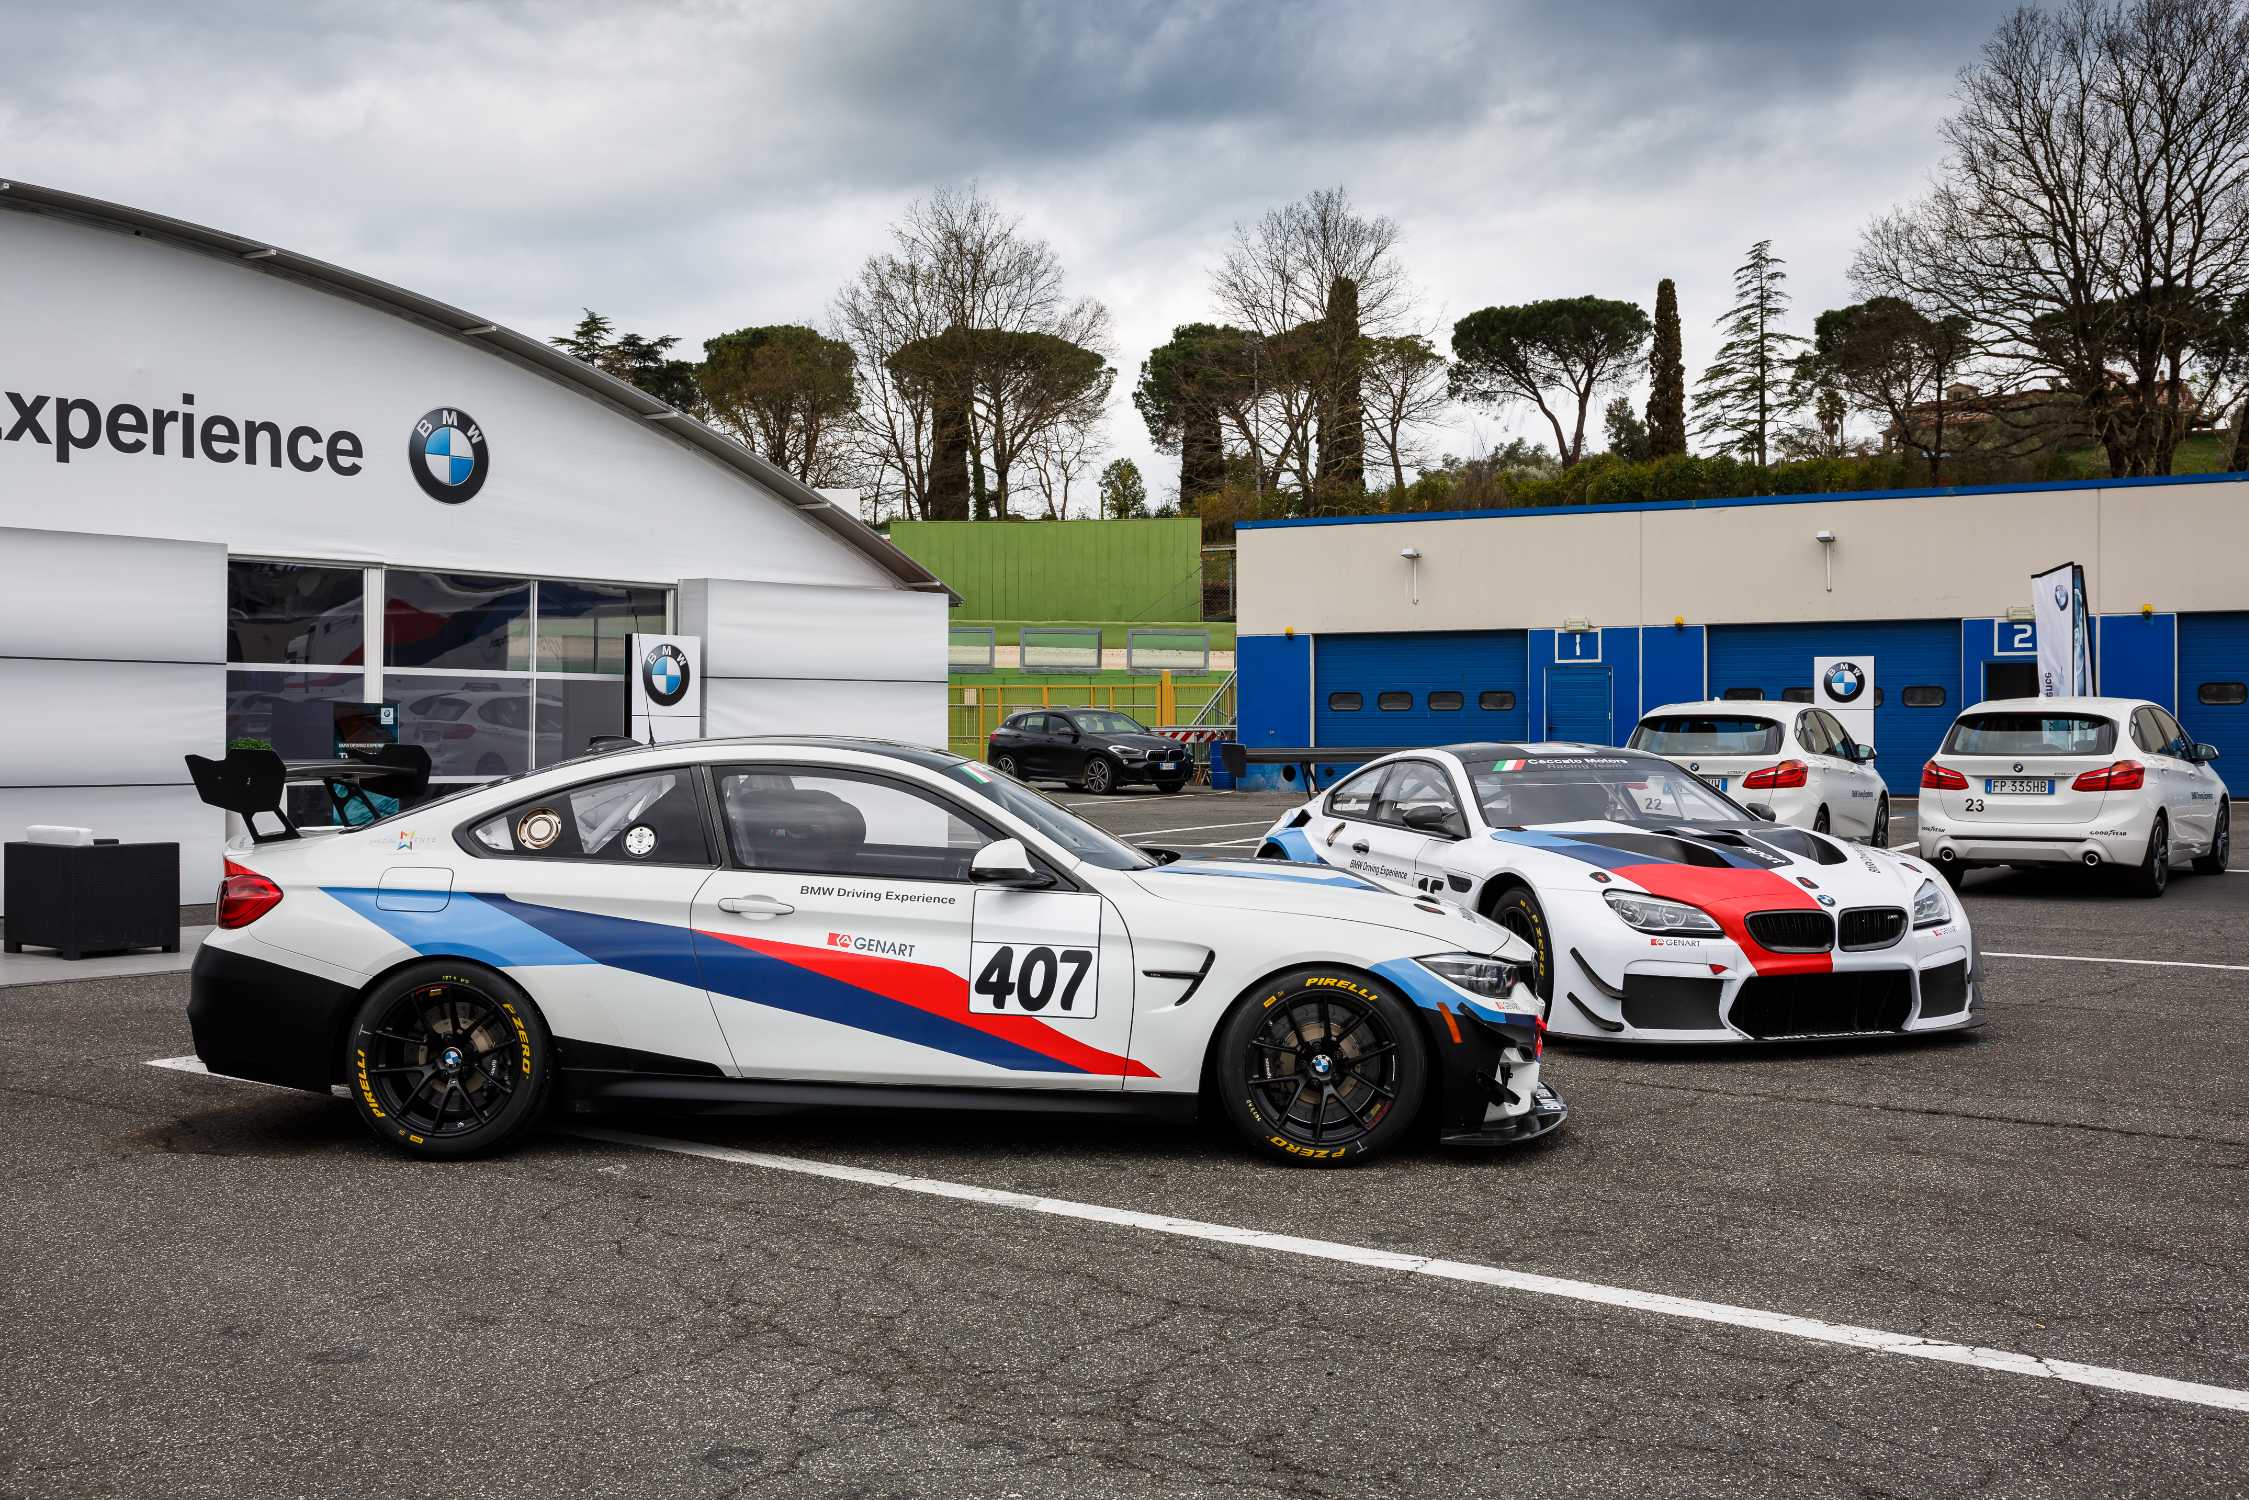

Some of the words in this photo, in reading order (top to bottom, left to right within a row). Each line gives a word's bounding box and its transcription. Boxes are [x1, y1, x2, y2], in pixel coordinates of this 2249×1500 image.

[0, 391, 364, 477] xperience
[416, 409, 483, 445] BMW
[2014, 624, 2033, 648] 2
[647, 645, 687, 667] BMW
[1827, 663, 1862, 677] BMW
[1992, 780, 2008, 793] FP
[2011, 780, 2047, 793] 335HB
[1645, 797, 1662, 811] 22
[1965, 798, 1985, 813] 23
[1350, 859, 1363, 871] BMW
[1363, 861, 1380, 875] Driving
[1380, 864, 1408, 880] Experience
[800, 885, 835, 897] BMW
[837, 887, 882, 902] Driving
[885, 890, 956, 905] Experience
[853, 936, 916, 957] GENART
[1665, 939, 1701, 947] GENART
[975, 945, 1093, 1011] 407
[1305, 976, 1379, 1001] PIRELLI
[356, 1048, 386, 1119] PIRELLI
